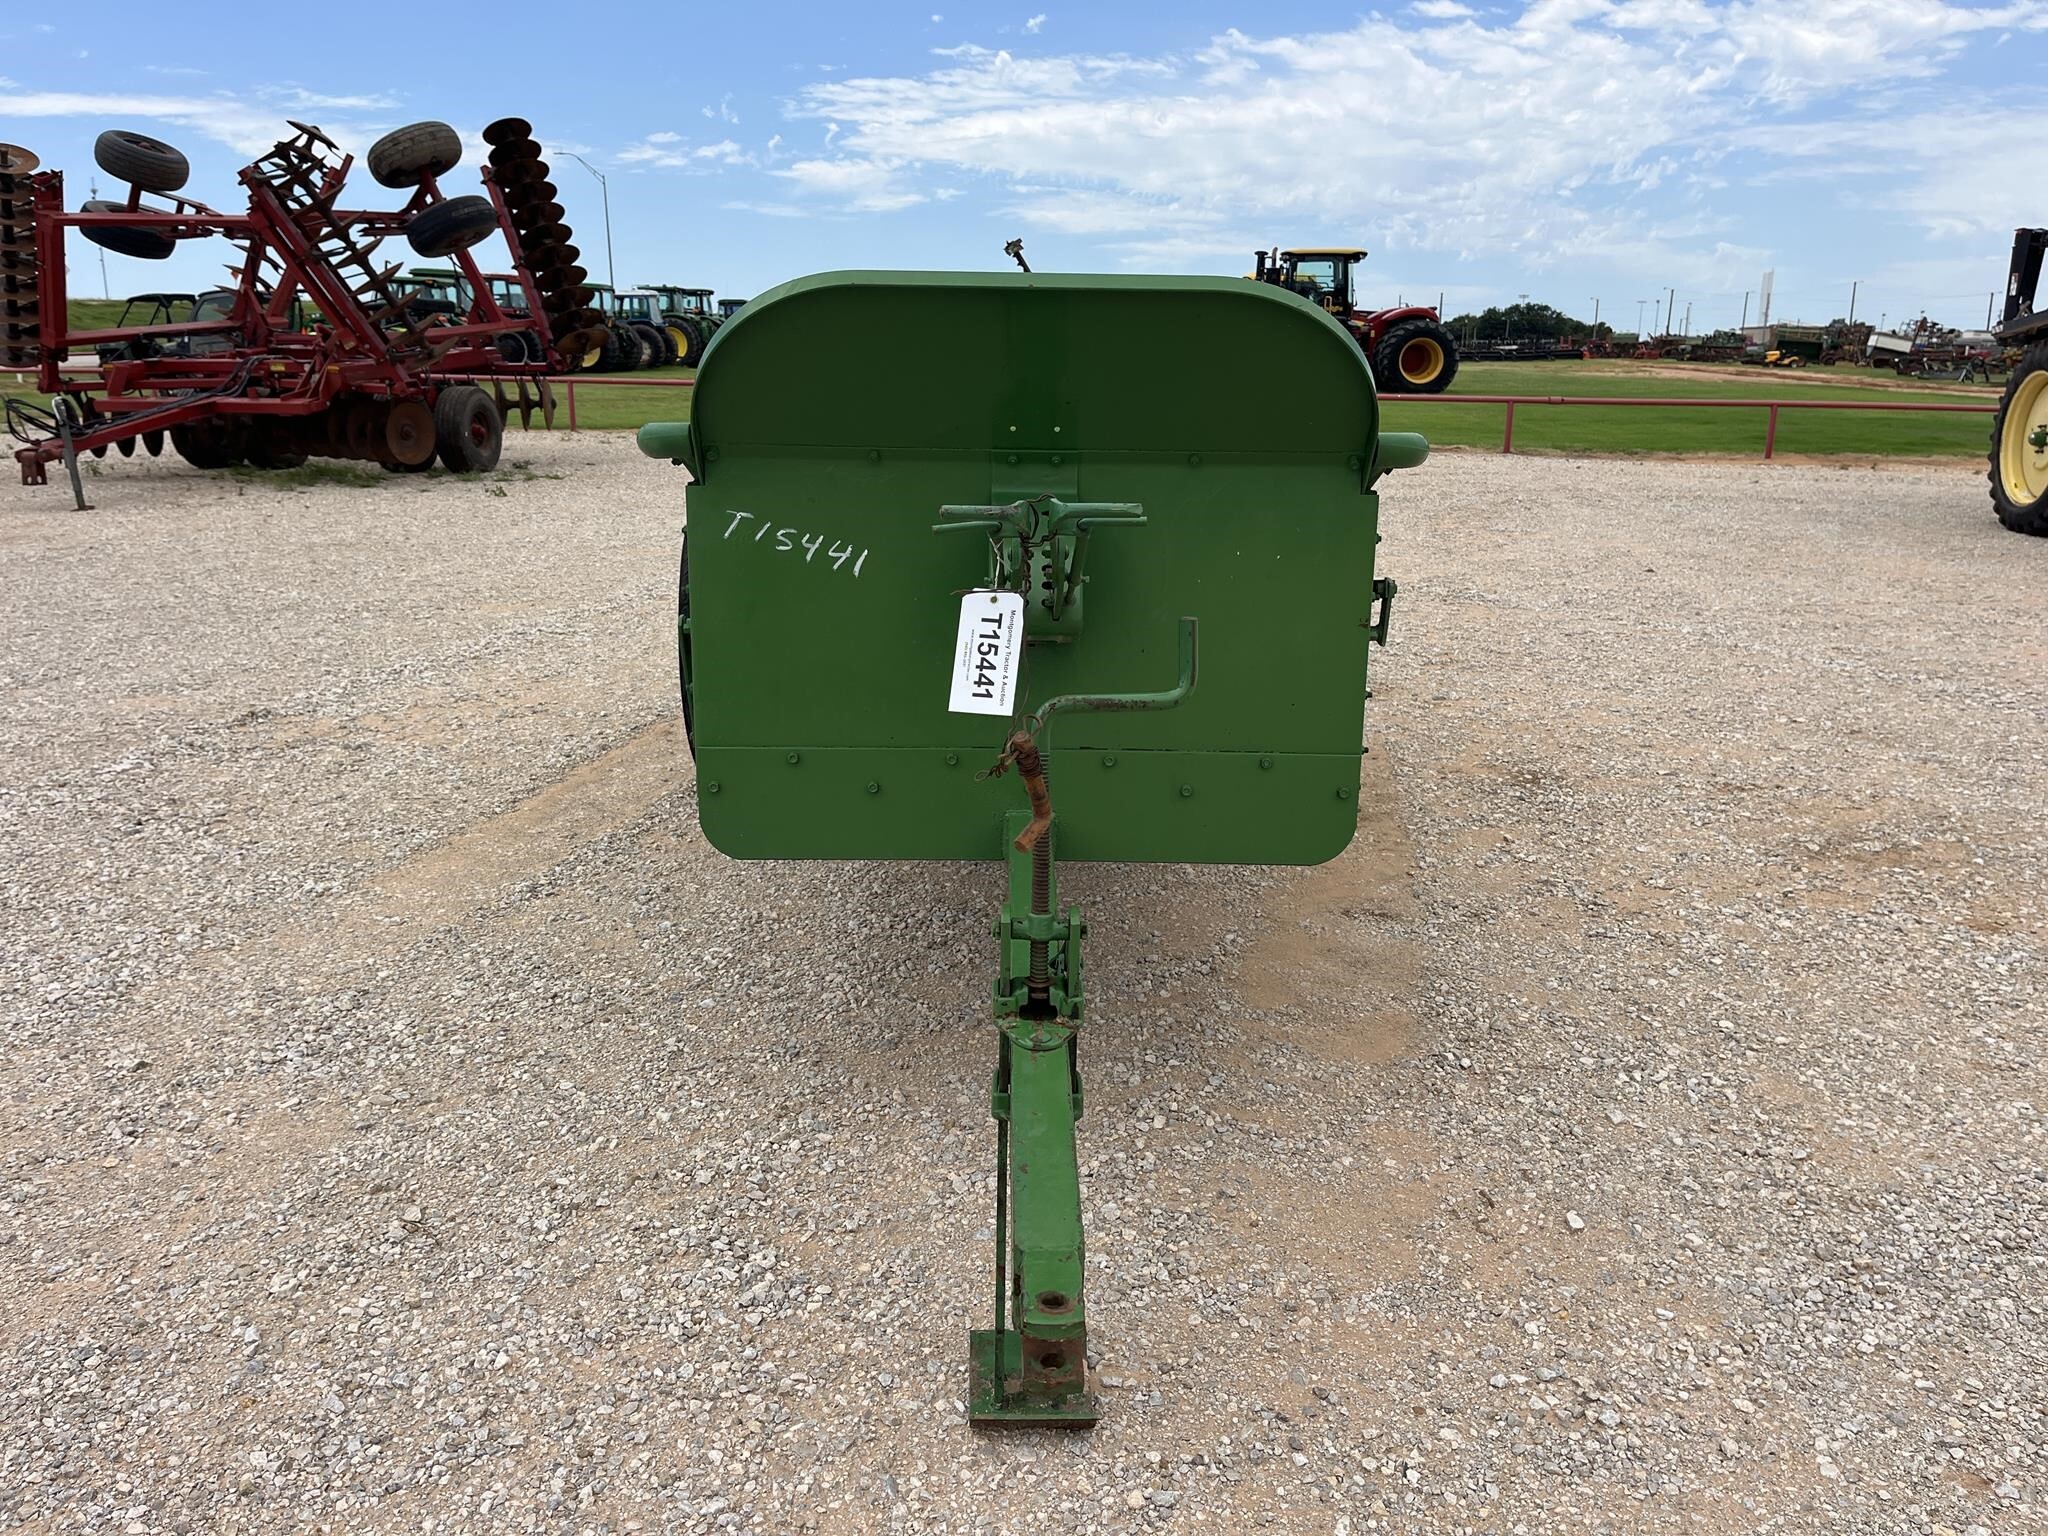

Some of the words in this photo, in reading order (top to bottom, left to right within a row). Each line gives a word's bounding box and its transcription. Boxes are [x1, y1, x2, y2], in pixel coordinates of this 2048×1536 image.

[724, 509, 868, 578] T15441
[1005, 609, 1017, 650] Montgomery
[972, 613, 1003, 699] T15441
[1003, 651, 1012, 673] Tractor
[999, 681, 1008, 707] Auction
